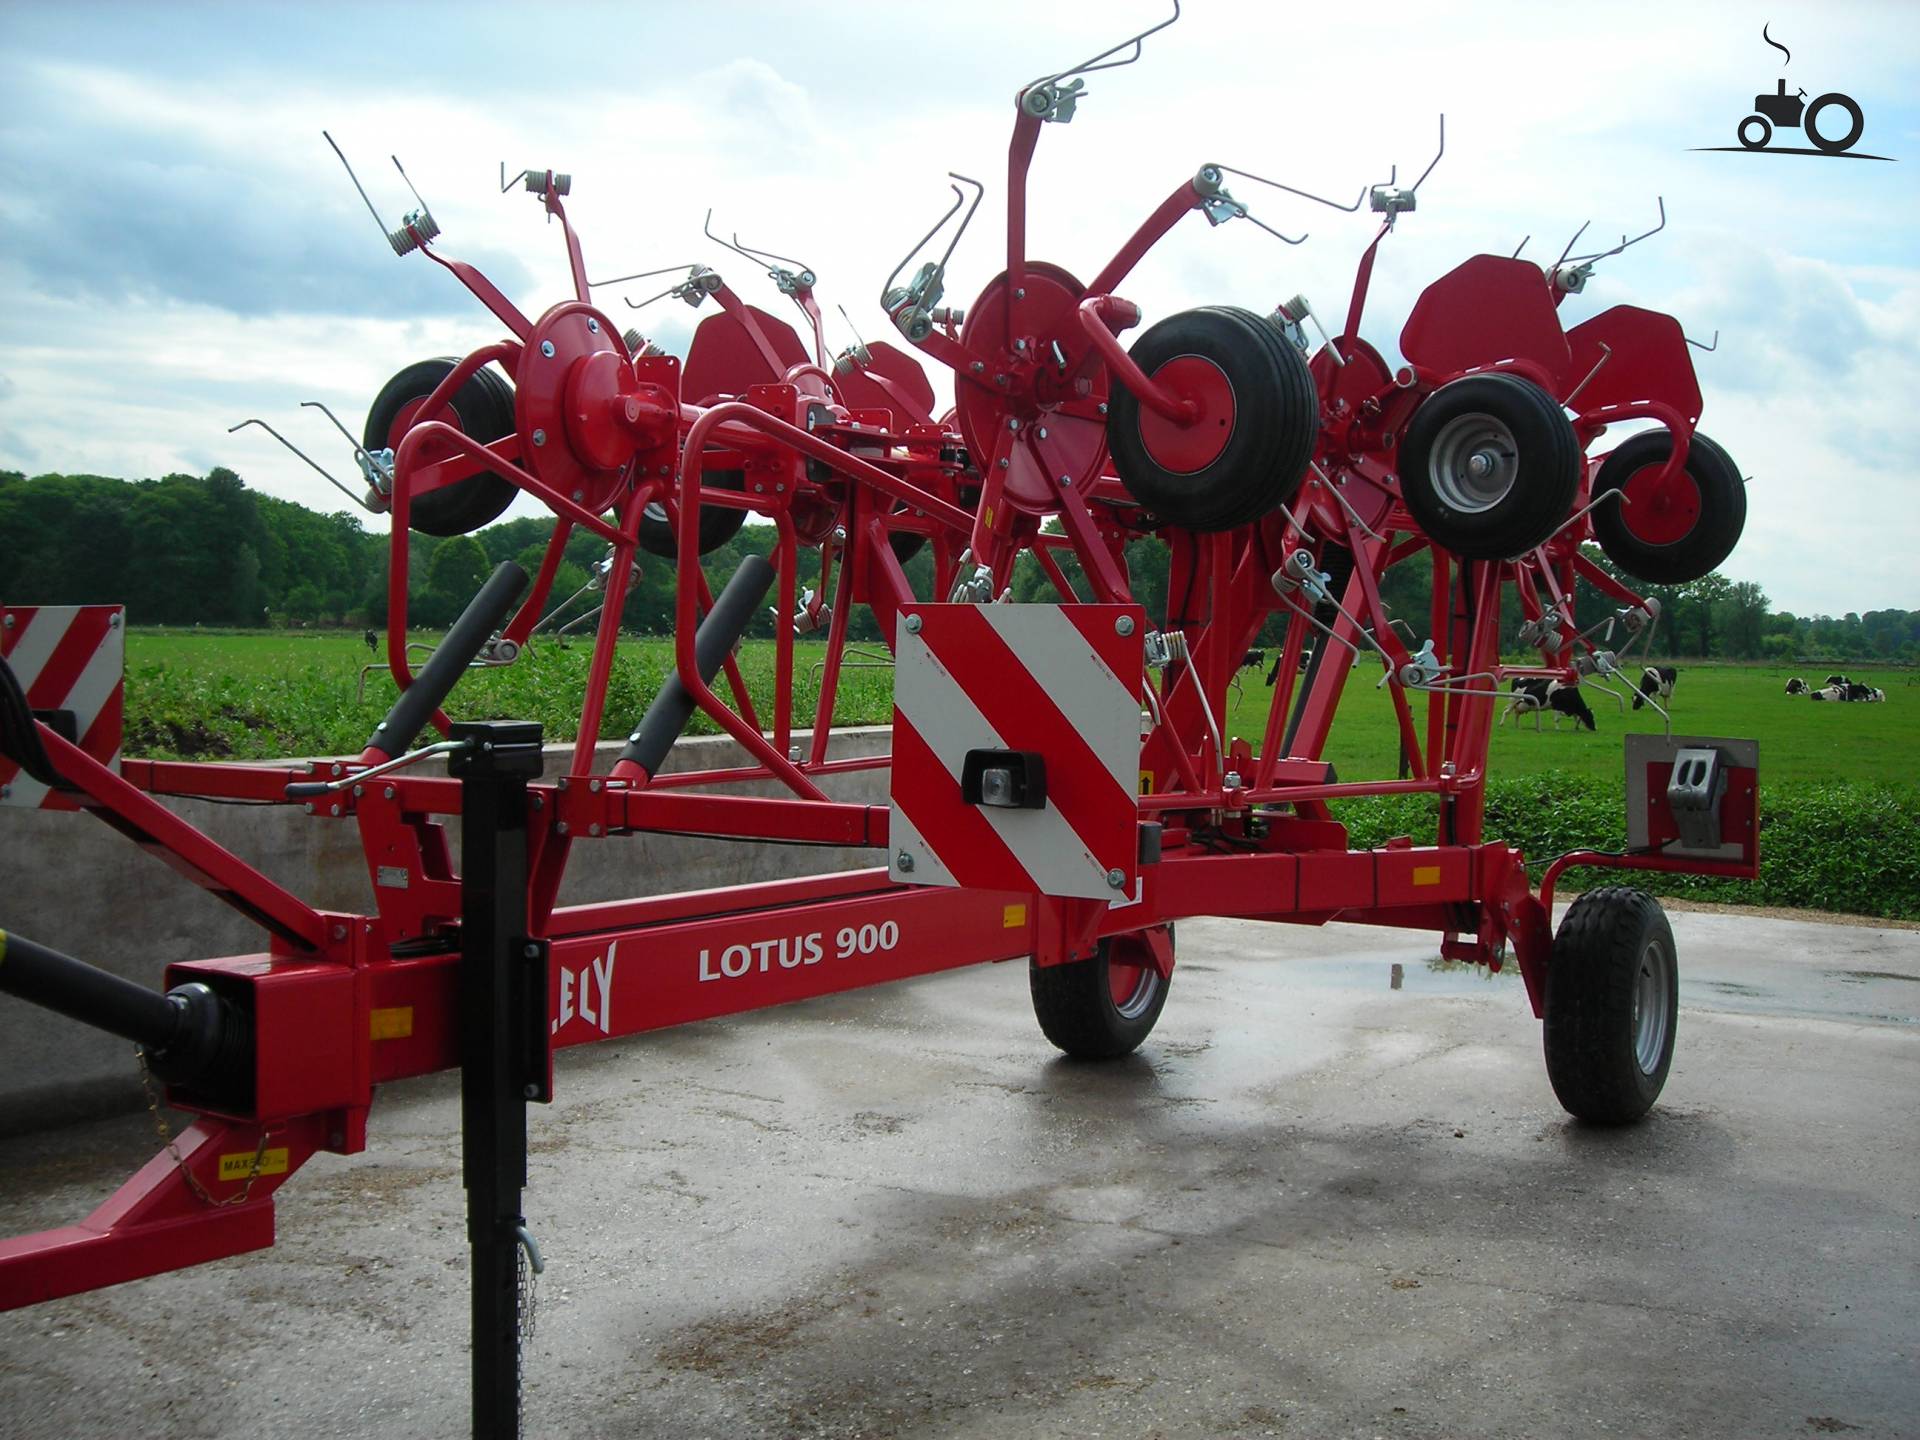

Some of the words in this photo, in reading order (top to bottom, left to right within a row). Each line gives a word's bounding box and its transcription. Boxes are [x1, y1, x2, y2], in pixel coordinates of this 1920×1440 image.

[551, 940, 617, 1035] ELY
[699, 933, 823, 982] LOTUS
[836, 920, 900, 959] 900
